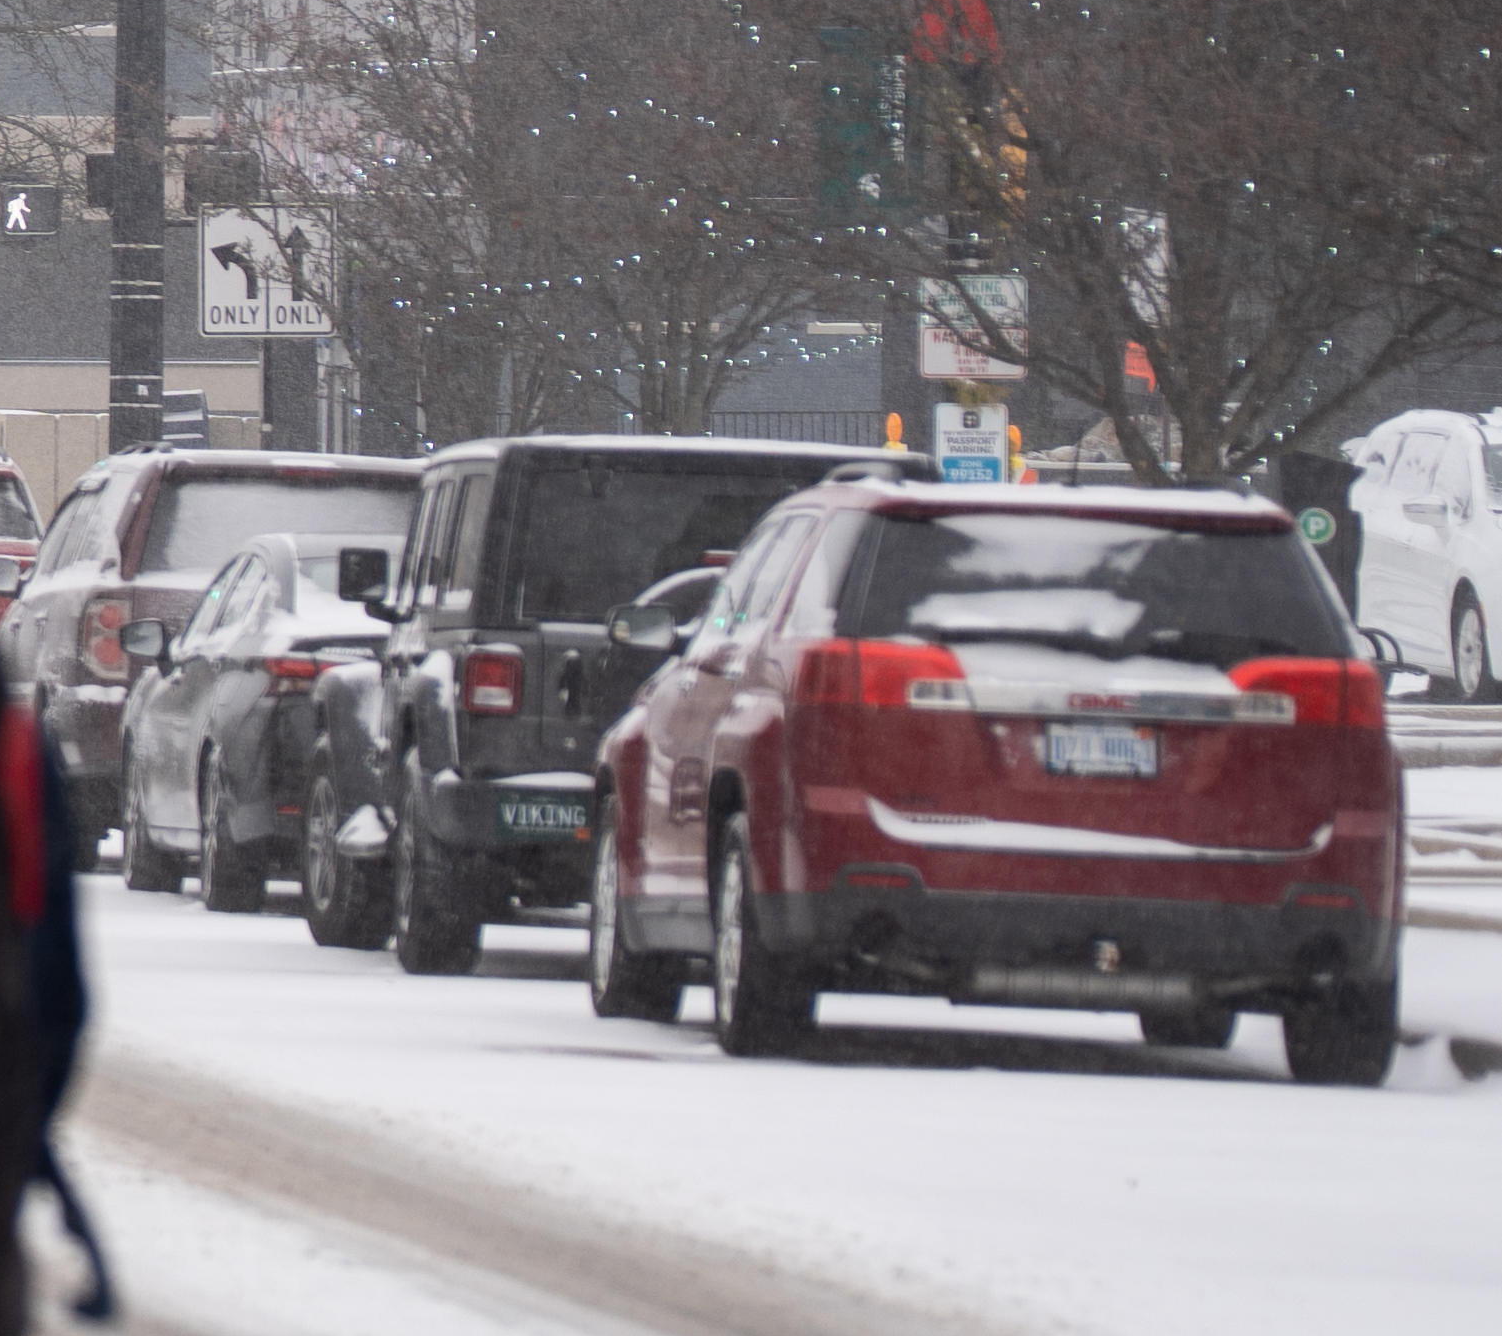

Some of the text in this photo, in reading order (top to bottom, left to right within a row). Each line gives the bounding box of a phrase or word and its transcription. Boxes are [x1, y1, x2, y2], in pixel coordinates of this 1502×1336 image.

[210, 305, 323, 325] ONLY ONLY
[500, 803, 587, 826] VIKING
